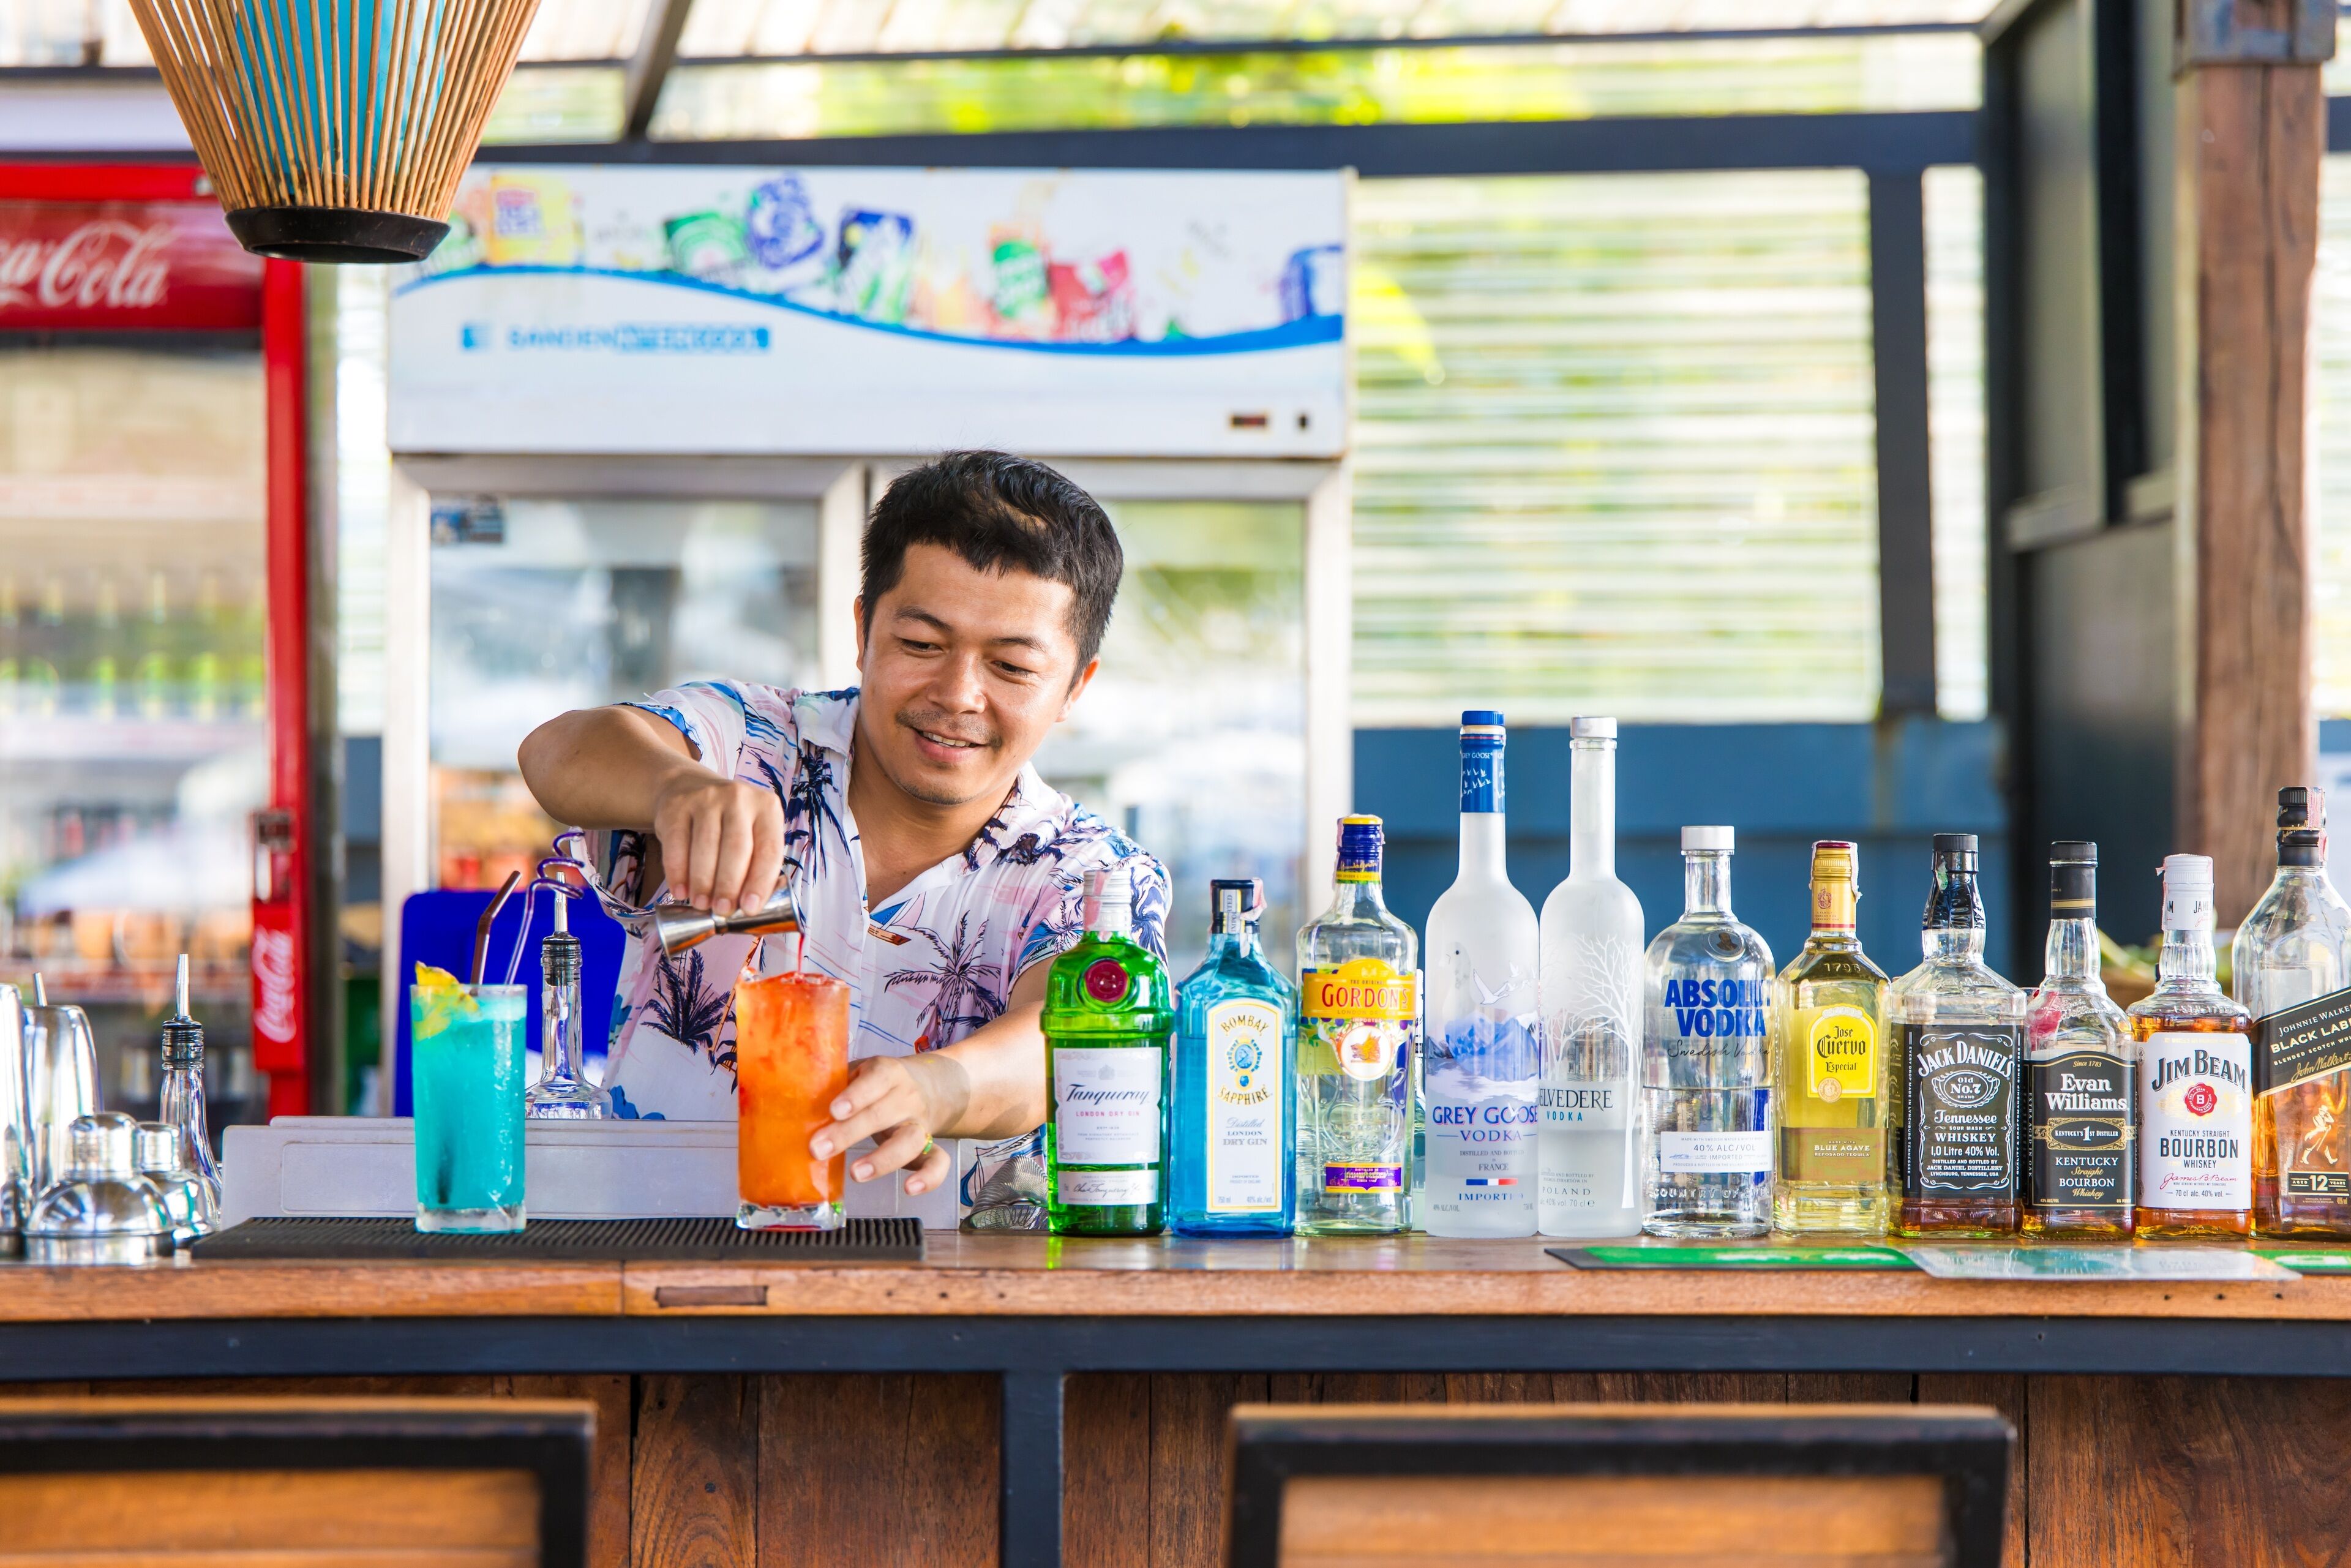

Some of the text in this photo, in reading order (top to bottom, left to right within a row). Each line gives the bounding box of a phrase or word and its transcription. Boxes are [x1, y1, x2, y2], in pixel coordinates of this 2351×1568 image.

[1220, 1014, 1269, 1033] BOMBAY
[1676, 1008, 1767, 1037] VODKA
[2279, 1016, 2319, 1037] JOHNNIE
[1833, 1026, 1853, 1040] Jose
[1667, 1039, 1731, 1058] Swedish
[1817, 1034, 1866, 1059] Cuervo
[2270, 1030, 2318, 1054] BLACK
[1916, 1040, 2015, 1078] JACK DANIEL'S
[2273, 1051, 2306, 1066] BLENDED
[2308, 1041, 2336, 1054] SCOTCH
[1826, 1062, 1858, 1073] Especial
[2151, 1049, 2246, 1093] JIM BEAM
[2290, 1062, 2314, 1083] John
[2060, 1073, 2113, 1092] Evan
[1066, 1084, 1150, 1106] Tanqueray
[1217, 1086, 1271, 1106] SAPPHIRE
[1539, 1088, 1614, 1111] ELVEDERE
[2197, 1094, 2205, 1105] B
[1225, 1117, 1265, 1128] Distilled
[1433, 1105, 1539, 1125] GREY GOOSE
[1547, 1111, 1583, 1122] VODKA
[1934, 1109, 1997, 1123] Tennessee
[1460, 1130, 1522, 1142] VODKA
[1935, 1133, 1997, 1142] WHISKEY
[1944, 1146, 1963, 1156] Litre
[1965, 1146, 1983, 1157] 40%
[1985, 1146, 2000, 1156] Vol.
[2028, 1147, 2033, 1157] IN
[2160, 1138, 2238, 1158] BOURBON
[2055, 1157, 2118, 1166] KENTUCKY
[2183, 1160, 2216, 1168] WHISKEY
[2071, 1166, 2104, 1176] Straight
[2059, 1178, 2115, 1187] BOURBON
[2159, 1172, 2199, 1190] James
[2309, 1174, 2328, 1191] 12
[1542, 1187, 1591, 1196] POLAND
[2072, 1188, 2104, 1200] Whiskey
[1580, 1199, 1586, 1208] cl
